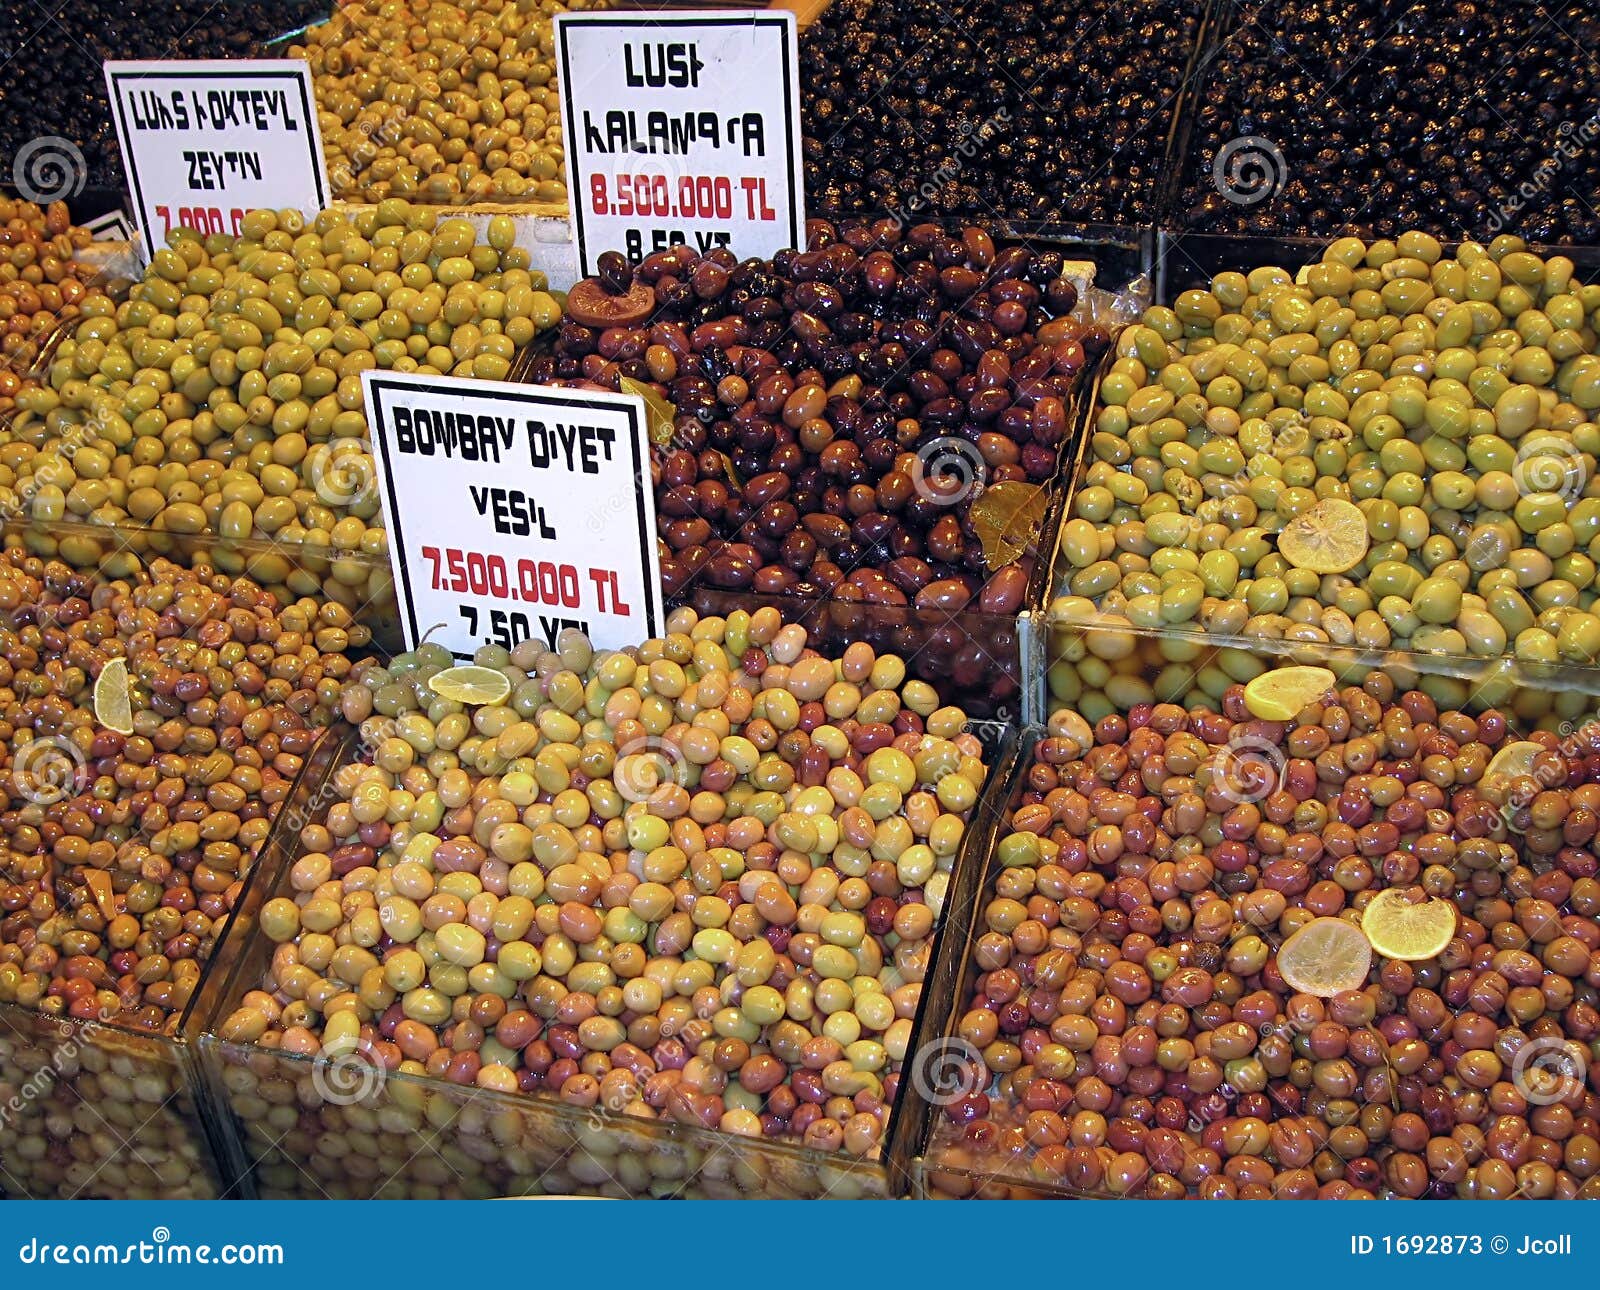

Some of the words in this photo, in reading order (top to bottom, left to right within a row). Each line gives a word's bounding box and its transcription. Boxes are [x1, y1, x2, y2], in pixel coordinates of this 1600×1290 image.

[590, 173, 732, 219] 8.500.000
[740, 177, 776, 221] TL
[421, 545, 580, 609] 7.500.000
[589, 568, 630, 616] TL
